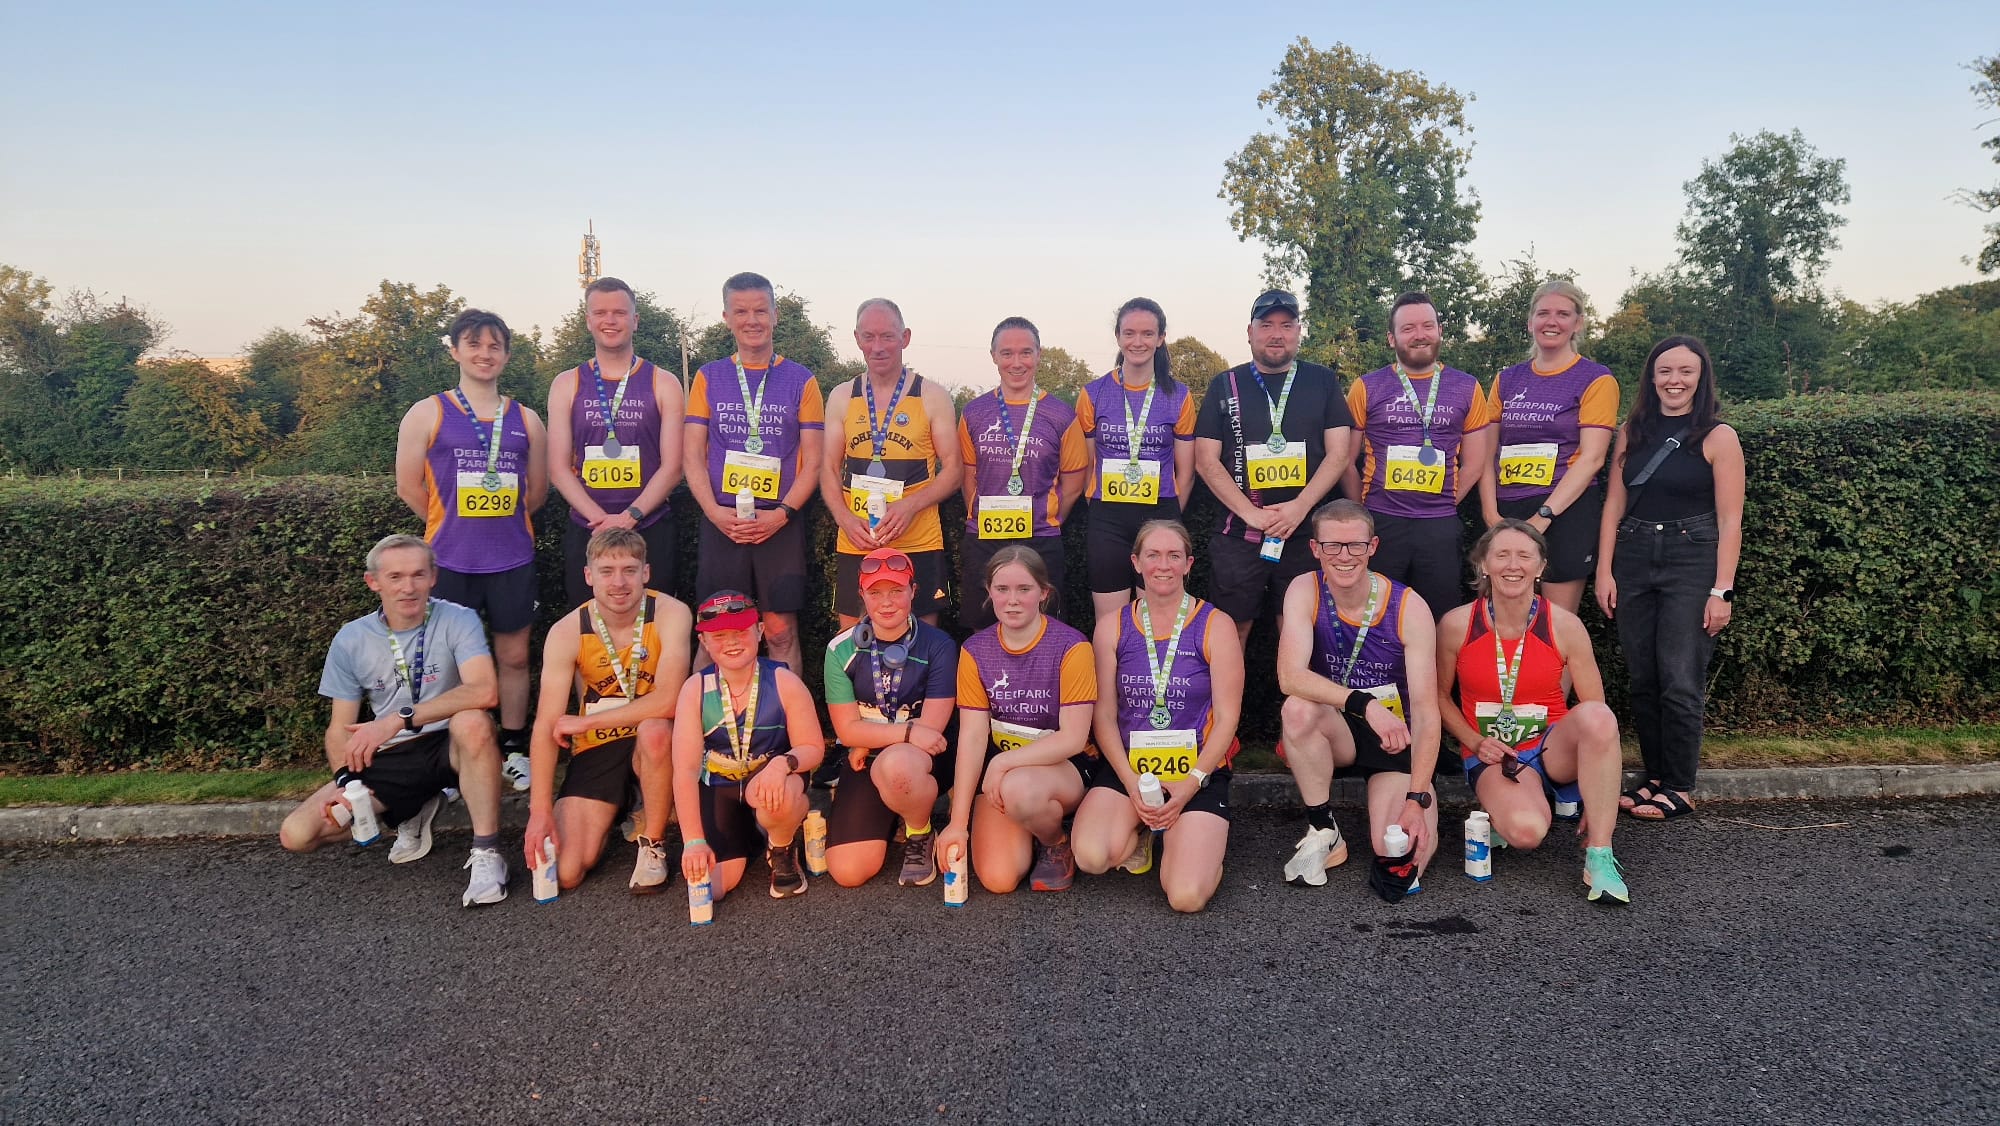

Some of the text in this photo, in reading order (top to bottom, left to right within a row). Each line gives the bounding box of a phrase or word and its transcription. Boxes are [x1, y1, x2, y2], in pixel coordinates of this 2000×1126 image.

[1503, 400, 1563, 411] DEERPARK
[720, 413, 783, 424] PARRUN
[1388, 415, 1450, 426] PARKUN
[1502, 412, 1555, 422] PARKRUN
[1228, 397, 1244, 472] WILKINSTOWN
[980, 445, 1040, 458] PARKUN
[589, 467, 634, 482] 6105
[1255, 464, 1301, 483] 6004
[1392, 468, 1438, 486] 6487
[1505, 462, 1546, 480] 6425
[728, 472, 773, 492] 6465
[1108, 481, 1152, 498] 6023
[466, 495, 512, 511] 6298
[853, 496, 869, 514] 64
[983, 517, 1026, 534] 6326
[1121, 674, 1191, 687] DEERARK
[1124, 686, 1186, 698] PARKUN
[1126, 698, 1185, 710] RUNNRS
[596, 726, 638, 740] 642
[1137, 755, 1191, 776] 6246
